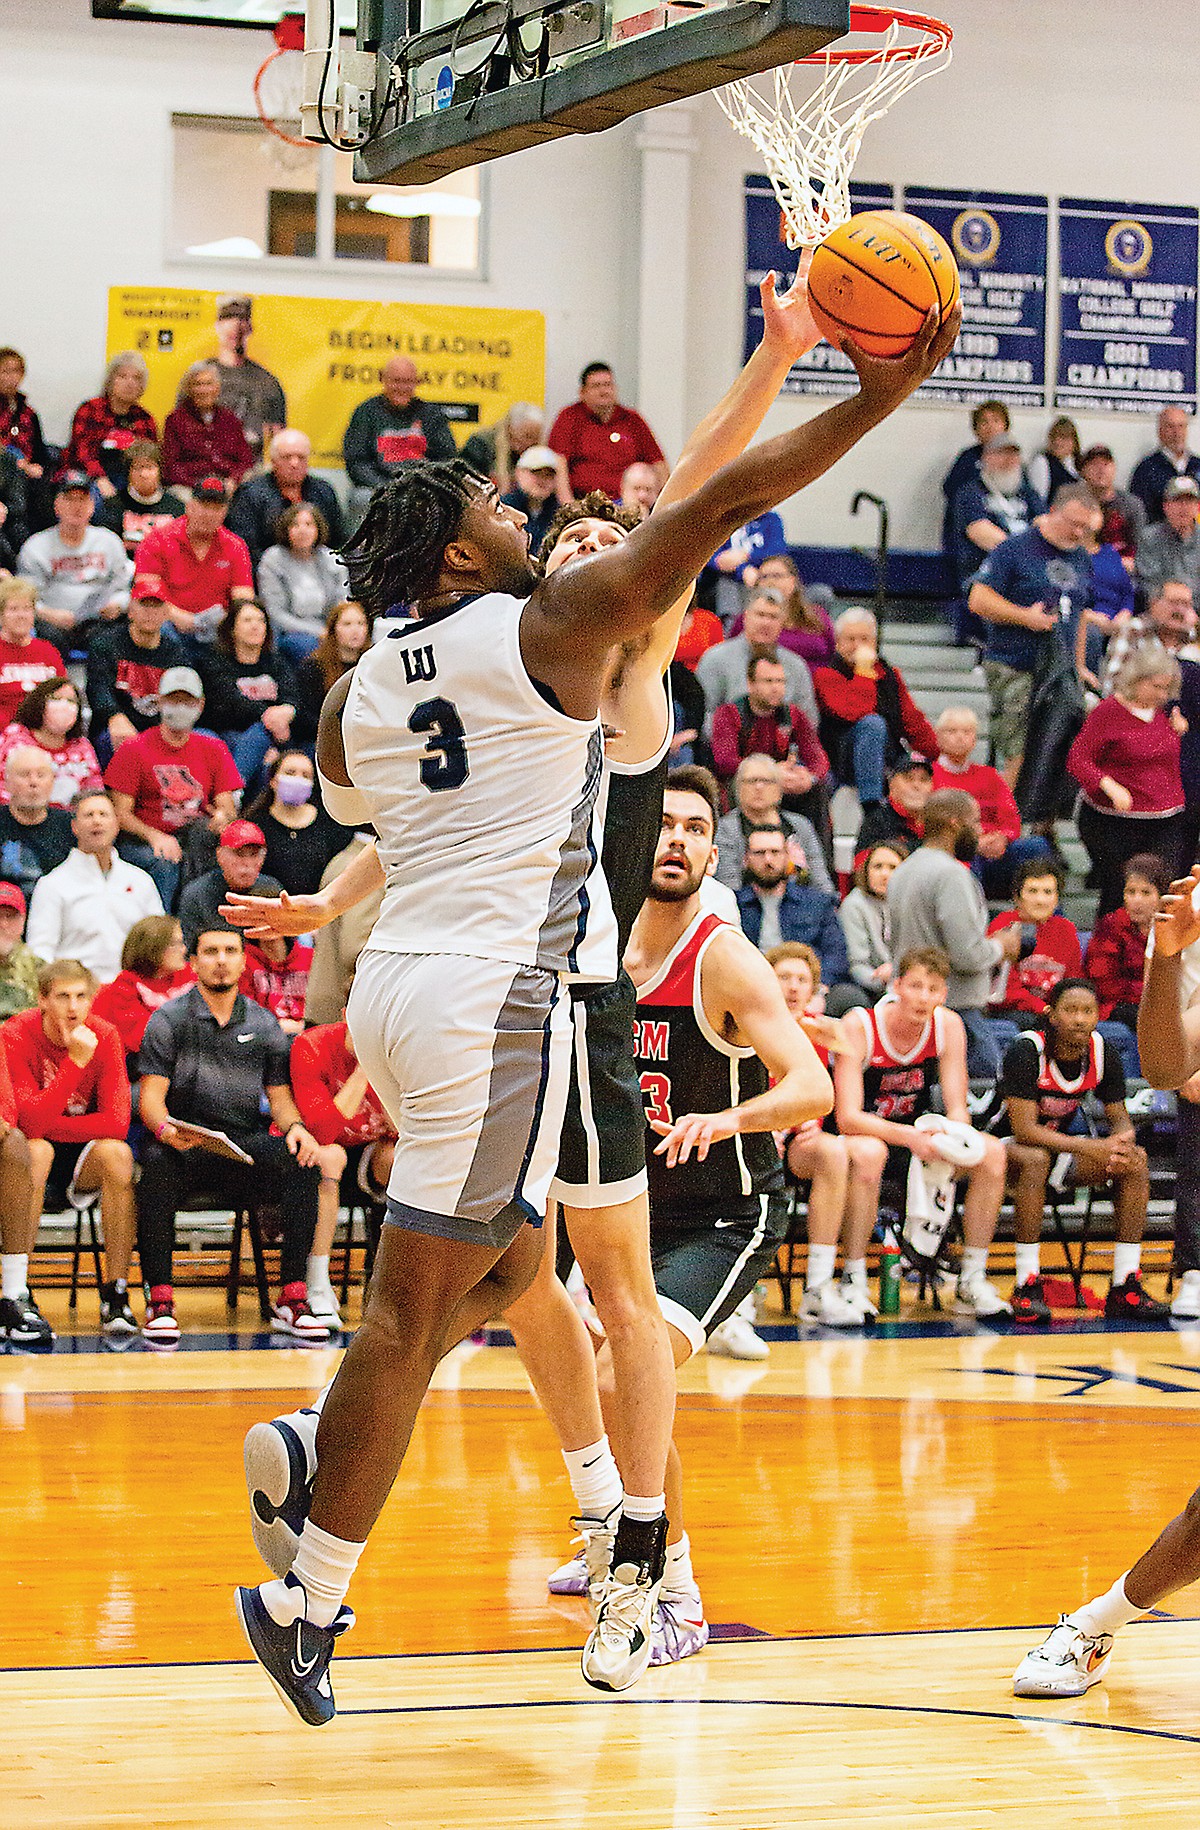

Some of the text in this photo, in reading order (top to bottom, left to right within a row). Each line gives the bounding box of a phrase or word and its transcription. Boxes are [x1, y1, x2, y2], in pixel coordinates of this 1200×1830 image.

[329, 329, 512, 358] BEGIN LEADING
[1067, 363, 1185, 393] CHAMPIONS
[399, 643, 438, 685] LU
[406, 694, 471, 793] 3
